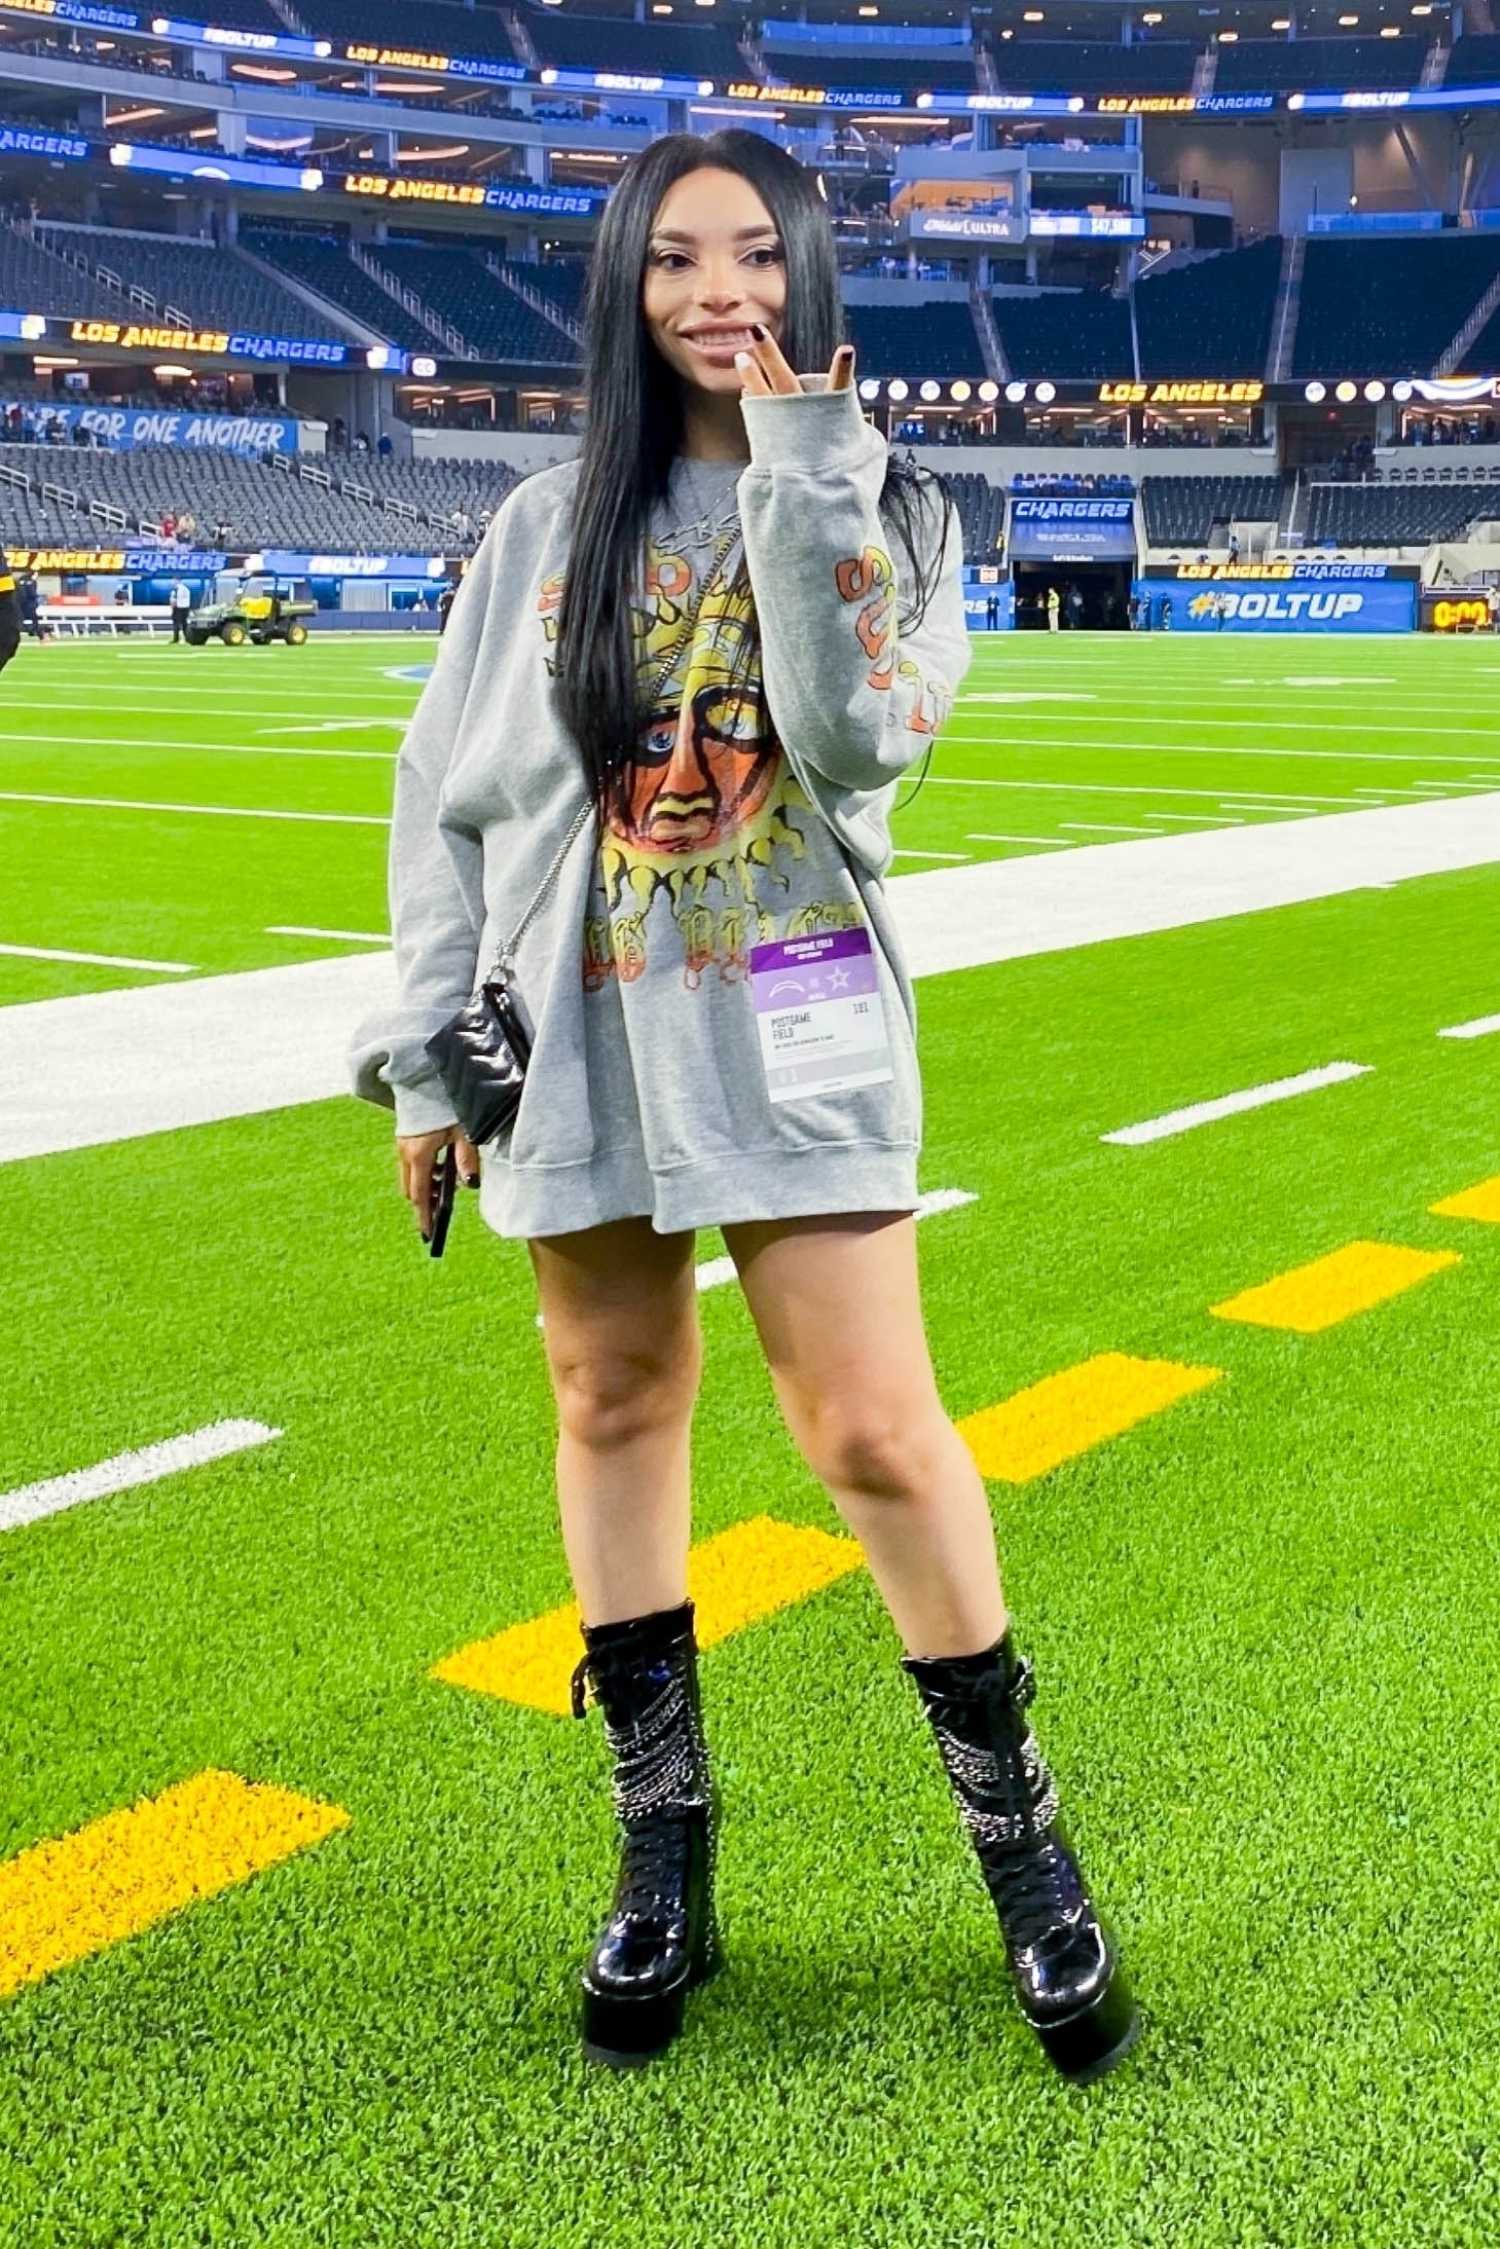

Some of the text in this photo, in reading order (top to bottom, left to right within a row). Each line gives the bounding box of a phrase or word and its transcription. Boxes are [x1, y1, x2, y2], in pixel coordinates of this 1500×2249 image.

[55, 2, 138, 27] CHARGERS
[346, 46, 526, 79] LOS ANGELES CHARGERS
[728, 84, 902, 106] LOS ANGELES CHARGERS
[1098, 96, 1273, 112] LOS ANGELES CHARGERS
[345, 175, 592, 213] LOS ANGELES CHARGERS
[71, 321, 346, 362] LOS ANGELES CHARGERS
[1099, 383, 1264, 402] LOS ANGELES
[133, 414, 181, 444] ONE
[184, 418, 286, 449] ANOTHER
[1015, 501, 1131, 519] CHARGERS
[30, 551, 125, 571] ANGELES
[125, 553, 227, 571] CHARGERS
[1176, 565, 1387, 581] LOS ANGELES CHARGERS
